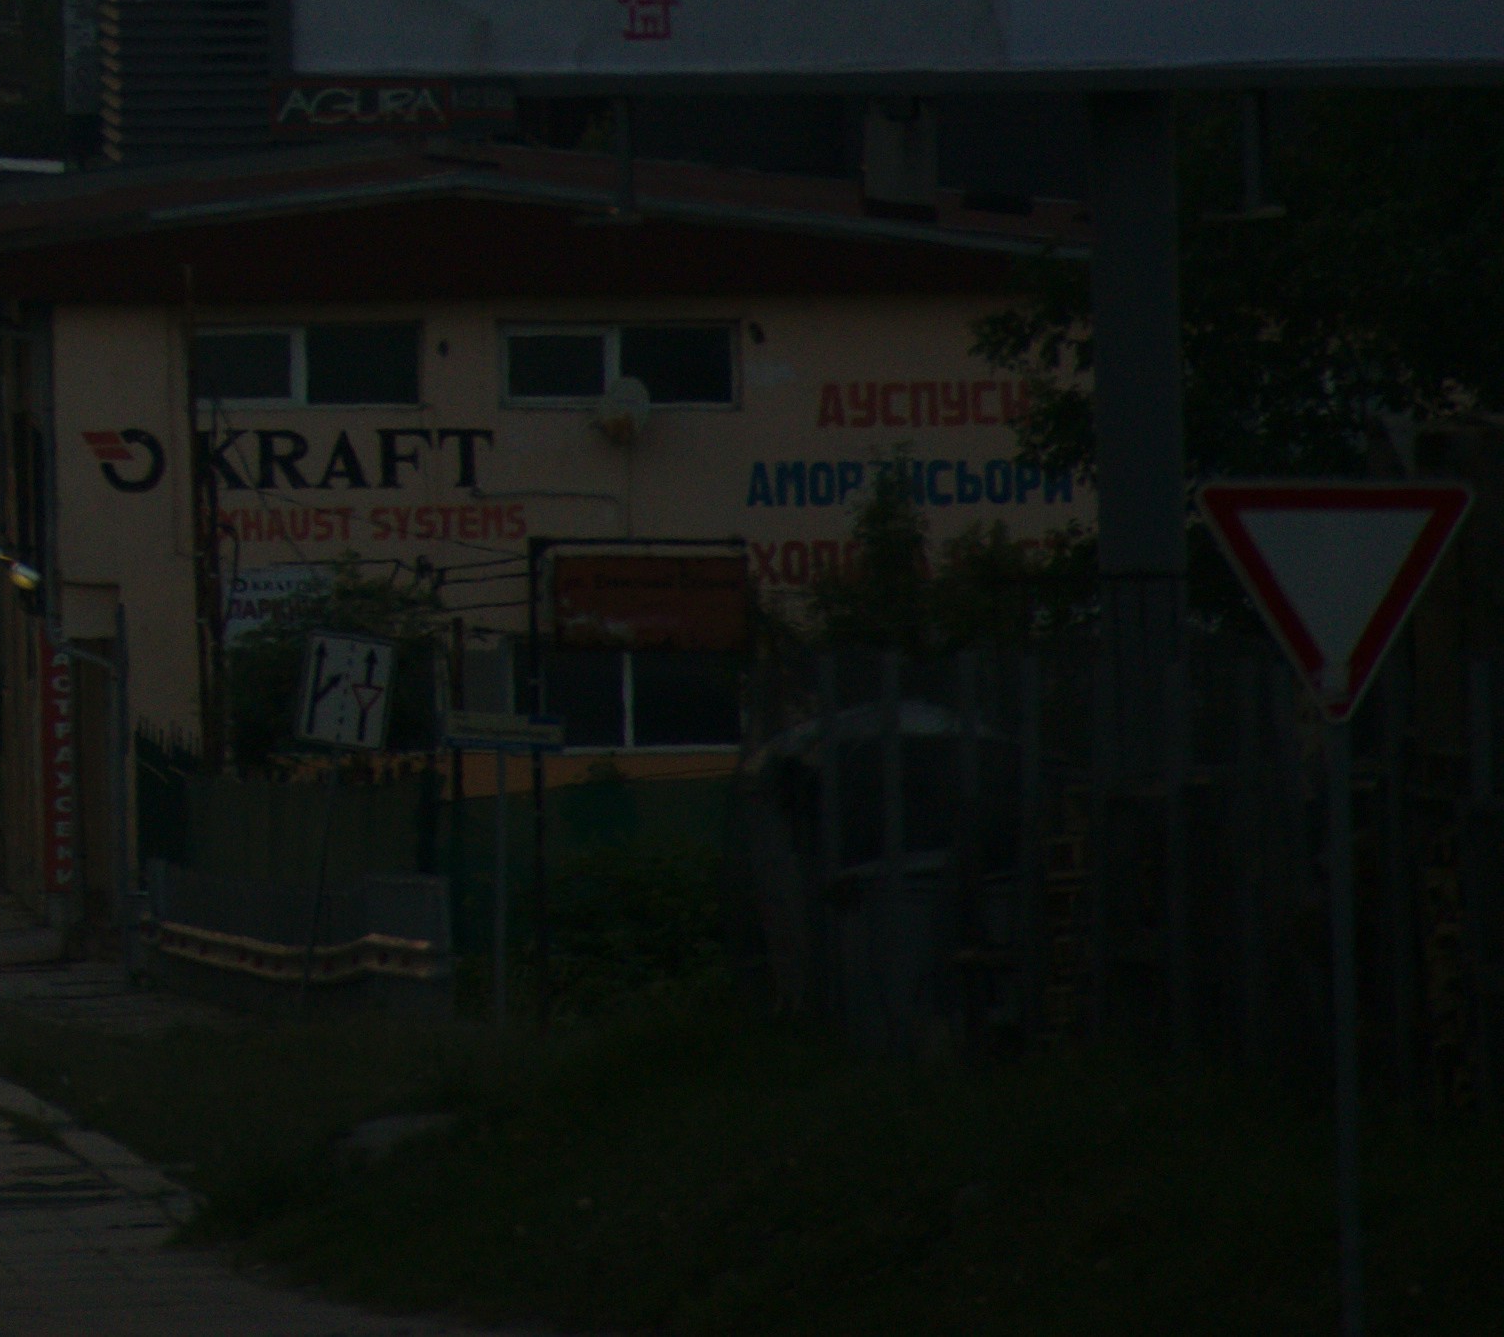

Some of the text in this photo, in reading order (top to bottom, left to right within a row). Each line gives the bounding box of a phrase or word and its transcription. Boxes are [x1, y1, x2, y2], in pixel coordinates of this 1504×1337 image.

[276, 86, 448, 126] AGURA
[196, 426, 494, 493] KRAFT
[371, 504, 527, 541] SYSTEMS
